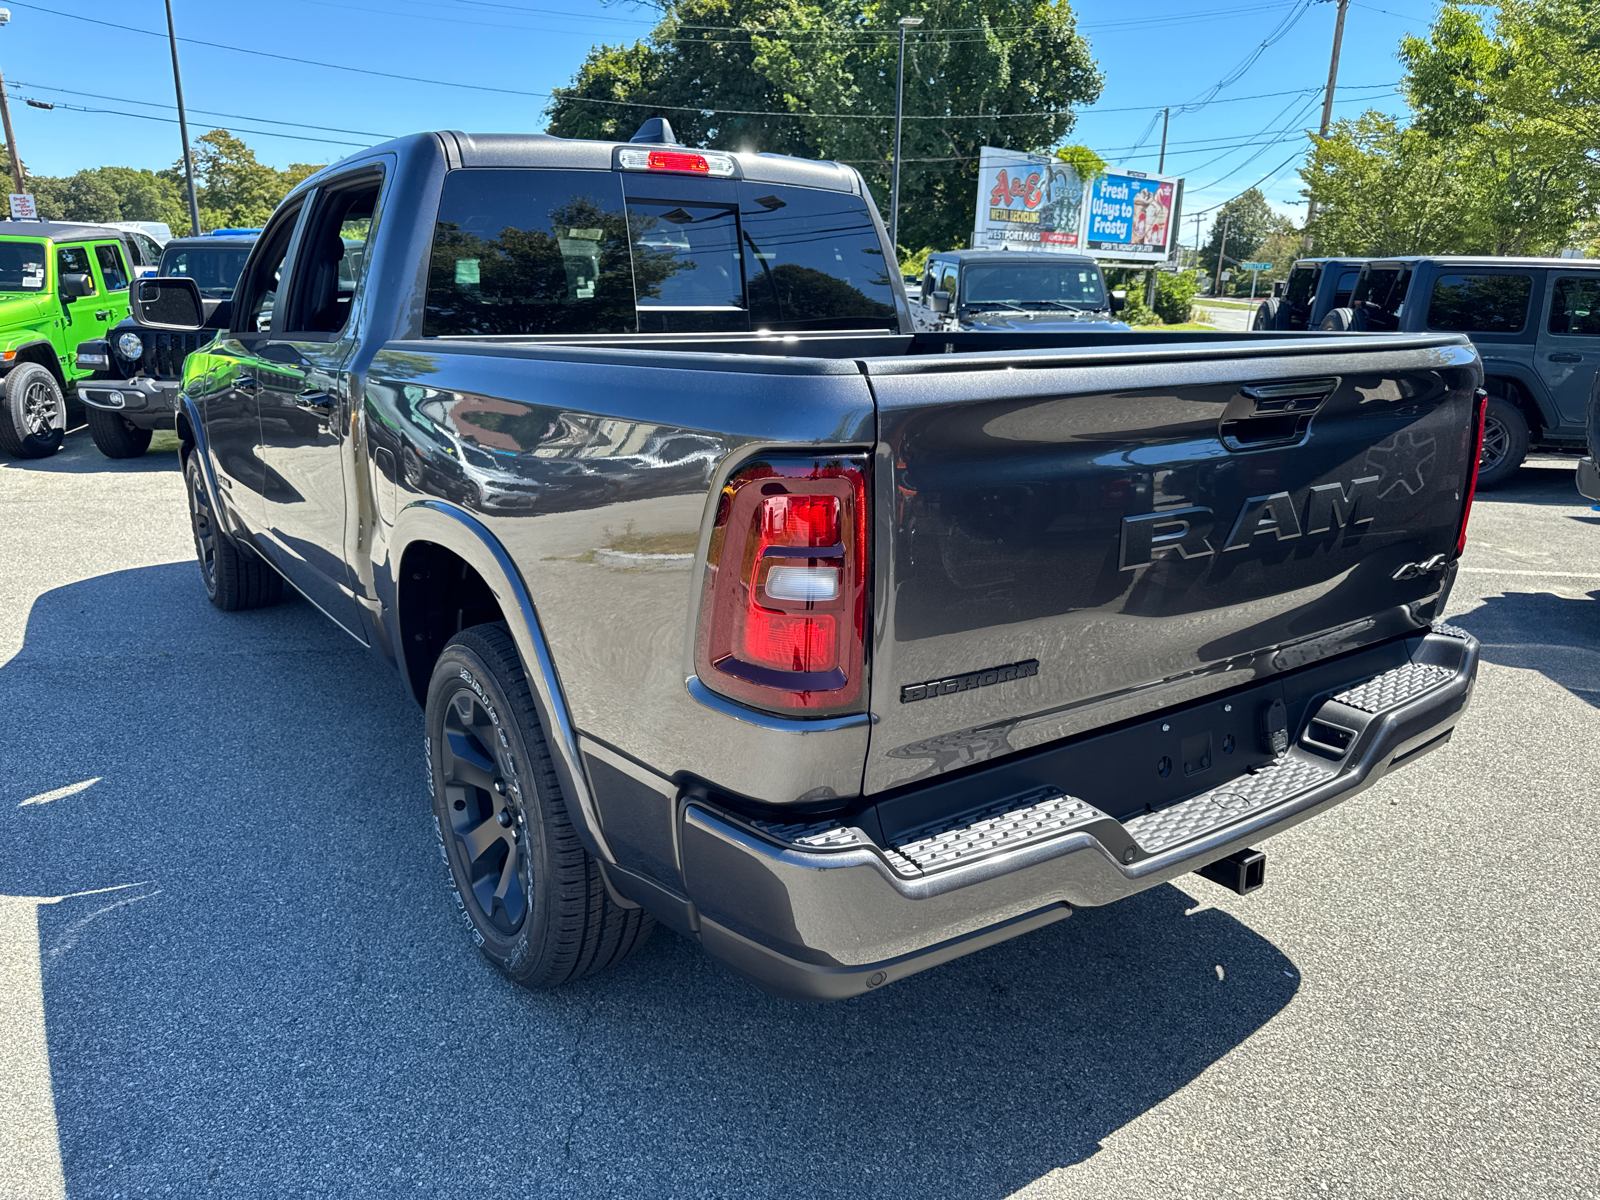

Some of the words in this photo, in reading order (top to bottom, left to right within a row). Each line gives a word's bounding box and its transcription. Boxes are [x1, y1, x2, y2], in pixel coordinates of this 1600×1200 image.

[990, 169, 1042, 209] A&E
[1055, 187, 1078, 198] SCRAP
[1100, 181, 1129, 200] Fresh
[990, 208, 1008, 221] METAL
[1010, 209, 1040, 223] RECYCLING
[1092, 198, 1120, 221] Ways
[1121, 203, 1132, 218] to
[987, 228, 1022, 241] WESTPORT
[1023, 231, 1041, 242] MASS
[1094, 216, 1128, 240] Frosty
[1118, 475, 1379, 571] RAM
[900, 658, 1040, 704] BIGHORN
